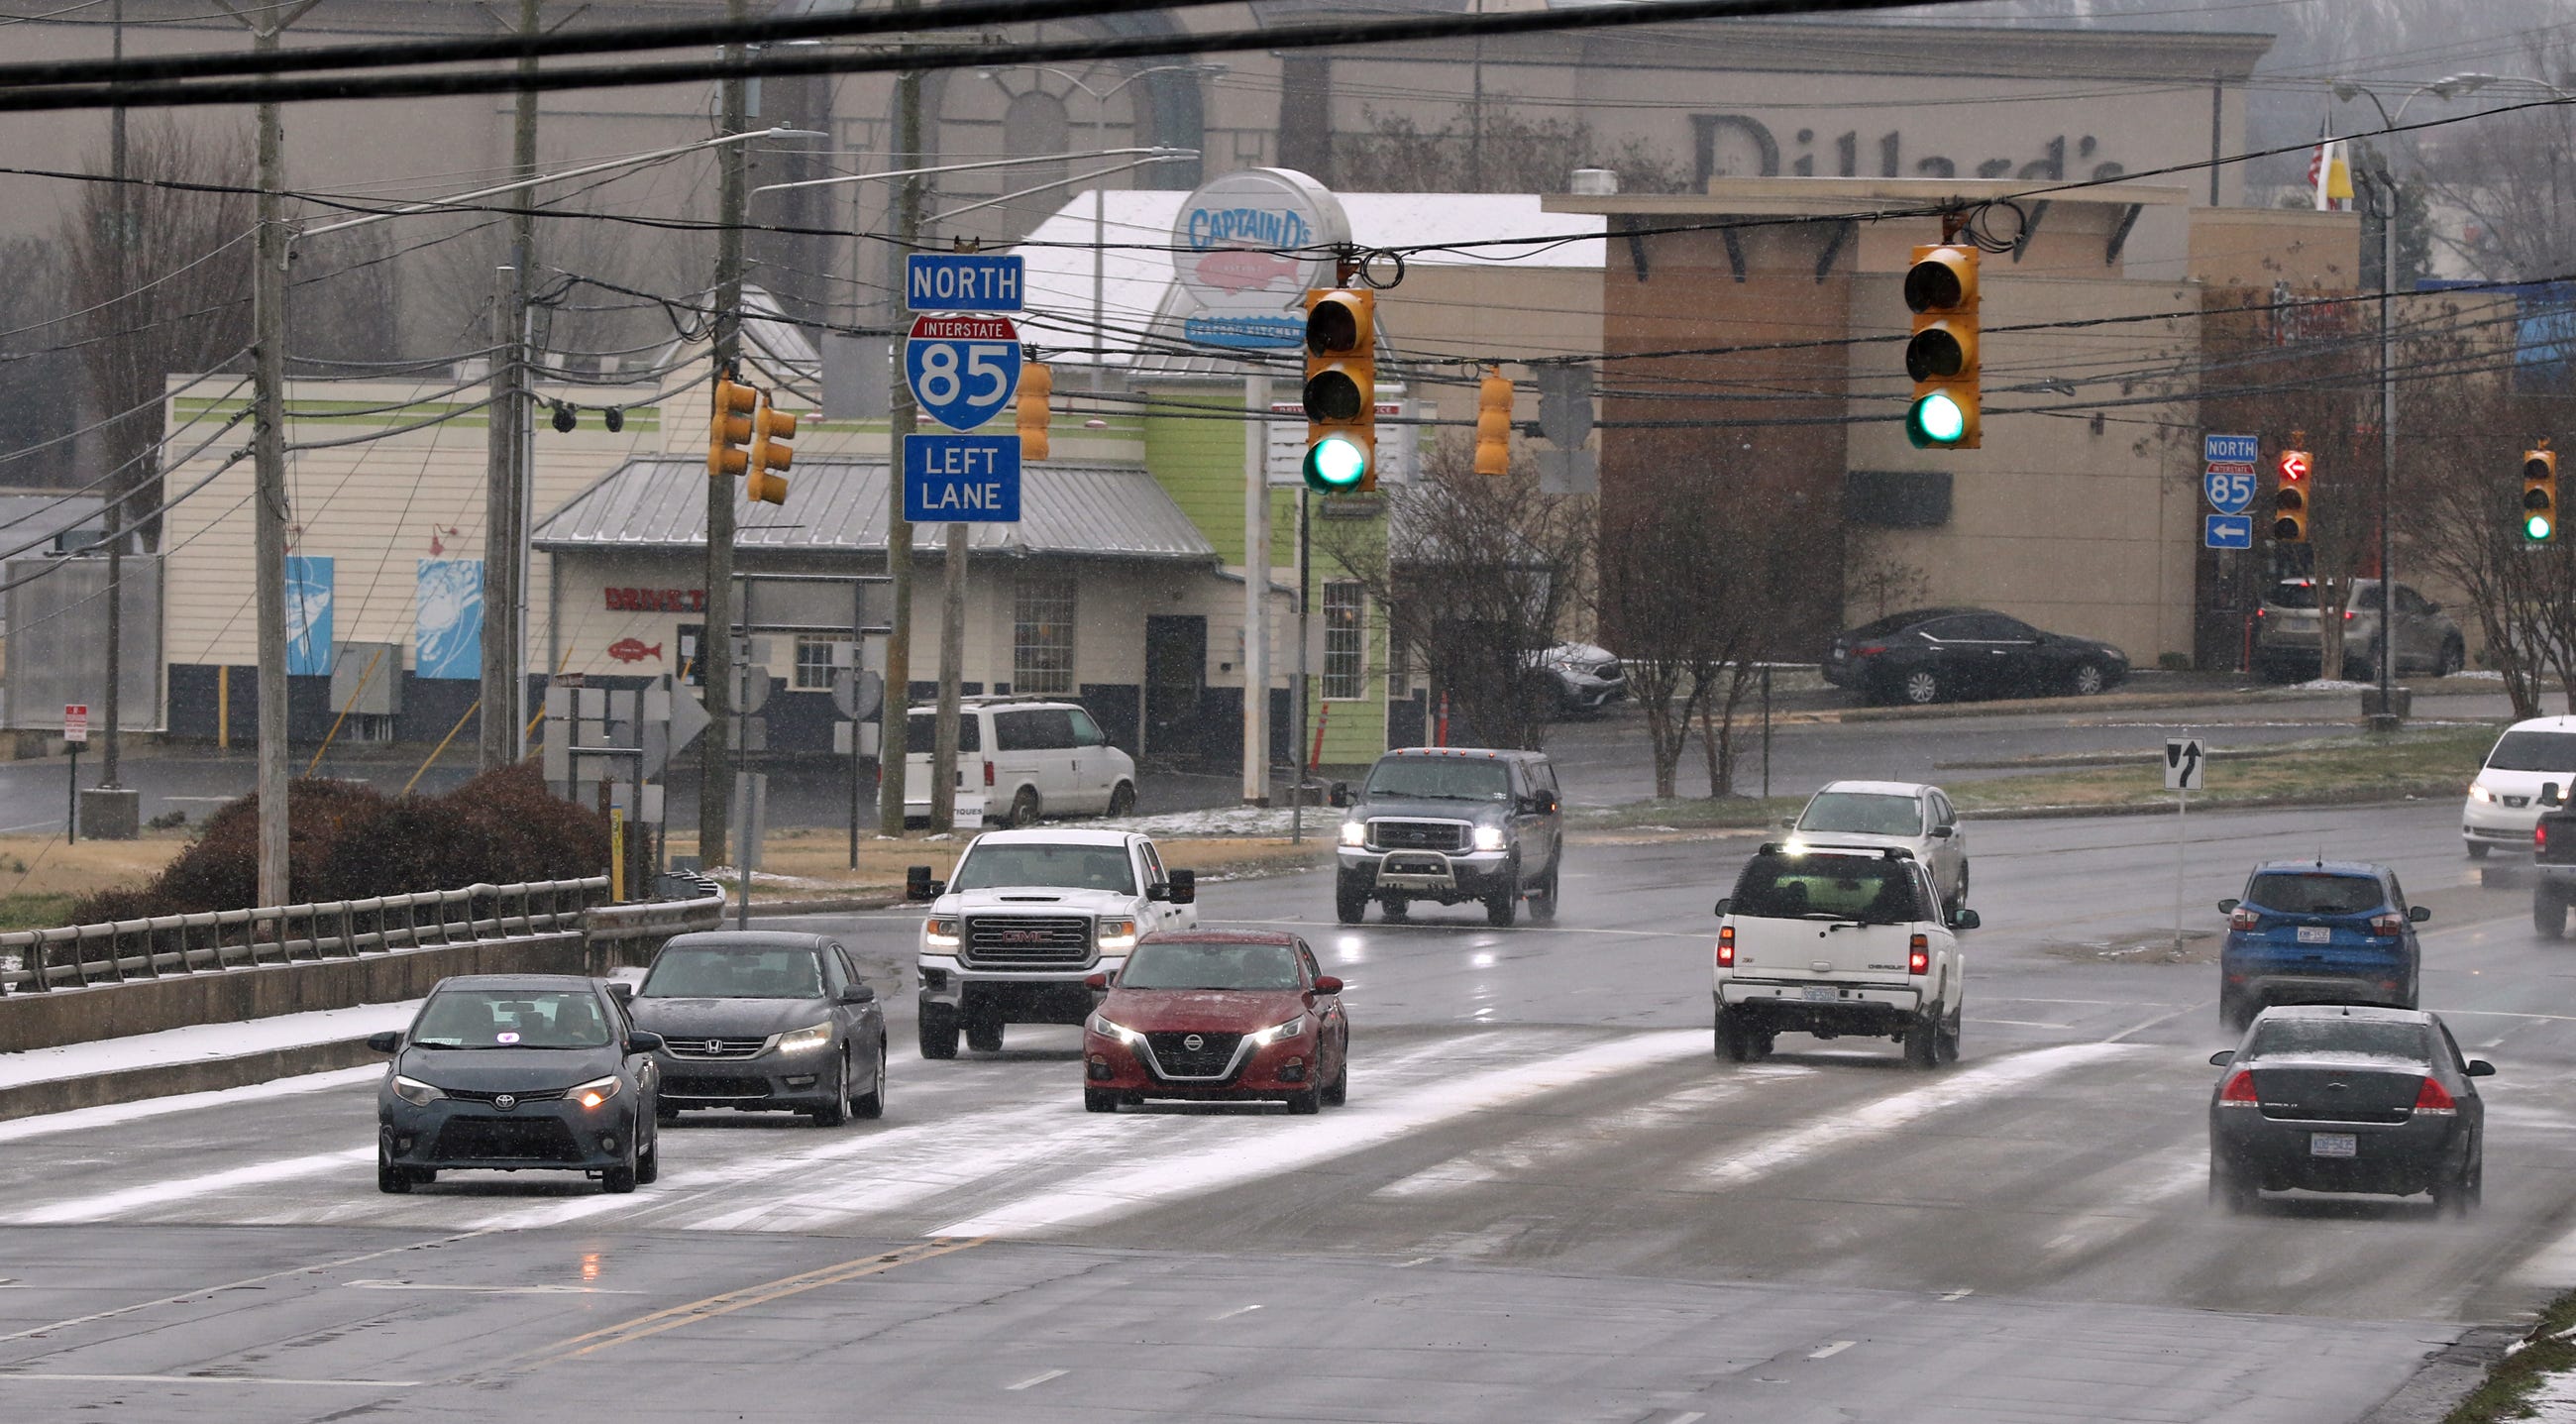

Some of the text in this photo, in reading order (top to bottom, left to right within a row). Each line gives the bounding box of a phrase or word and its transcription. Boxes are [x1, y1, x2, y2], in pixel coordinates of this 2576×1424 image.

[1190, 208, 1282, 250] CAPTAIN
[913, 267, 1017, 299] NORTH
[923, 322, 1004, 338] INTERSTATE
[918, 343, 1009, 407] 85
[926, 448, 999, 475] LEFT
[2208, 441, 2254, 457] NORTH
[922, 483, 1002, 509] LANE
[2210, 475, 2251, 503] 85
[604, 587, 683, 612] DRIVE
[1002, 930, 1053, 942] GMC
